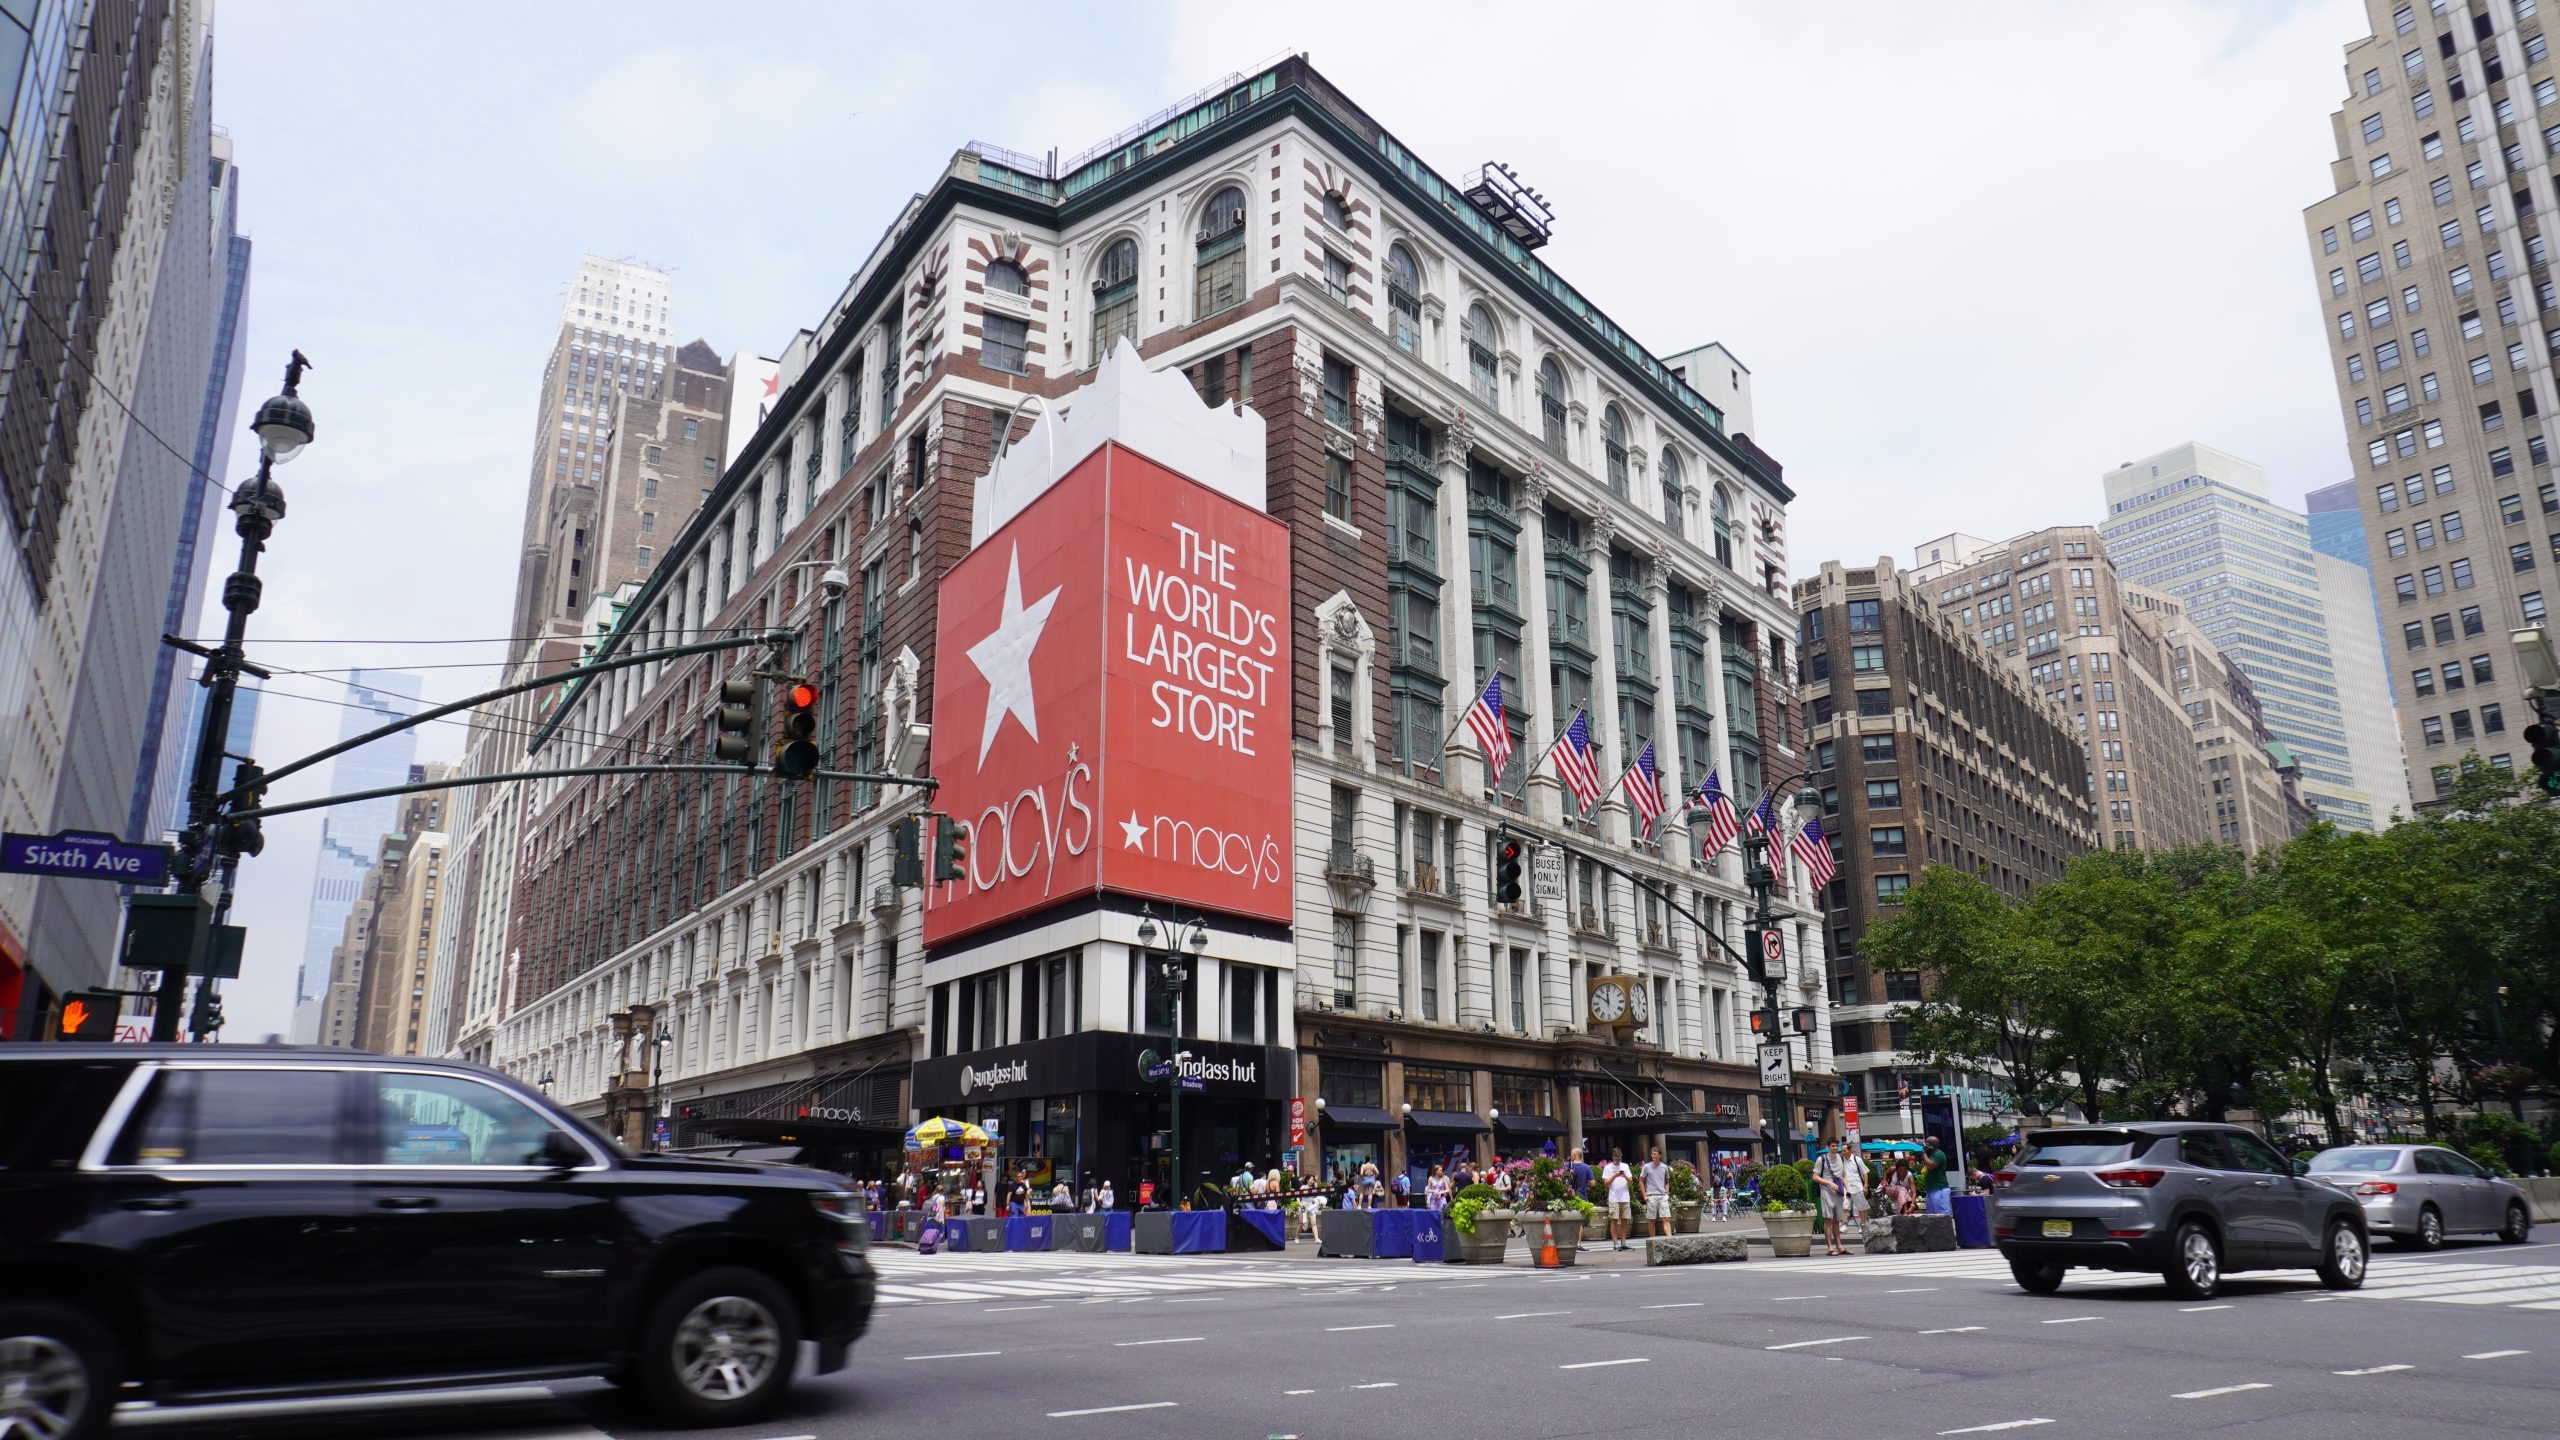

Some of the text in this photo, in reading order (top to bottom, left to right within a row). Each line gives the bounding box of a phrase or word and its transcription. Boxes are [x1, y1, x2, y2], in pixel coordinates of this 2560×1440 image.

[1172, 522, 1236, 590] THE
[1126, 557, 1277, 657] WORLD'S
[1127, 613, 1273, 706] LARGEST
[1151, 680, 1256, 757] STORE
[64, 836, 112, 846] BROADWAY
[24, 845, 141, 872] Sixth Ave
[1153, 814, 1281, 890] macy's
[1535, 858, 1561, 870] BUSES
[1537, 871, 1559, 883] ONLY
[1535, 884, 1560, 896] SIGNAL
[1764, 1048, 1784, 1057] KEEP
[973, 1059, 1028, 1092] sunglass hut
[1232, 1058, 1257, 1083] hut
[1764, 1073, 1788, 1082] RIGHT
[1182, 1080, 1203, 1090] Broadway
[810, 1106, 861, 1124] macy's
[1613, 1103, 1656, 1120] macy's
